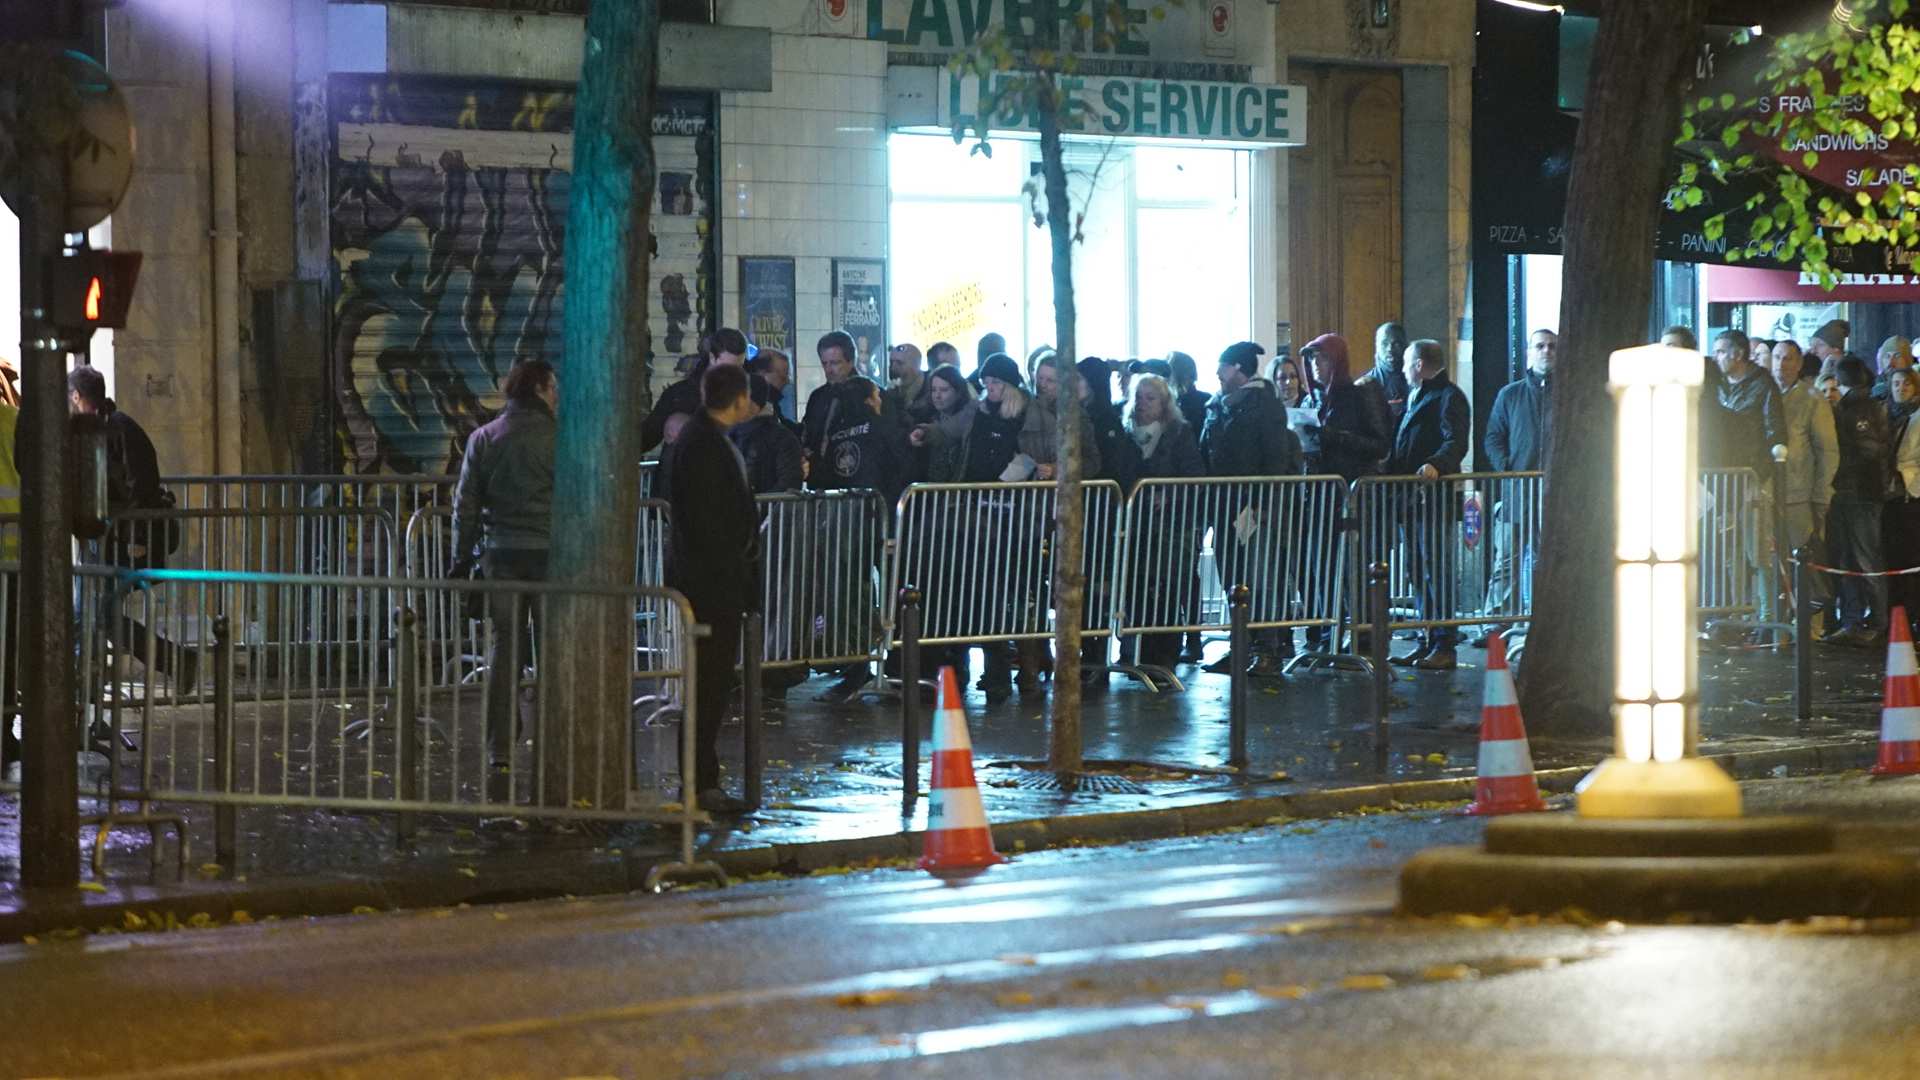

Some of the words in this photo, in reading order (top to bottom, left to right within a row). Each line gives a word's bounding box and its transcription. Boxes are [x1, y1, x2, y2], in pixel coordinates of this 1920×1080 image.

[867, 0, 1151, 55] LAVERIE
[1102, 79, 1290, 139] SERVICE
[1489, 225, 1527, 243] PIZZA
[1681, 233, 1727, 254] PANINI
